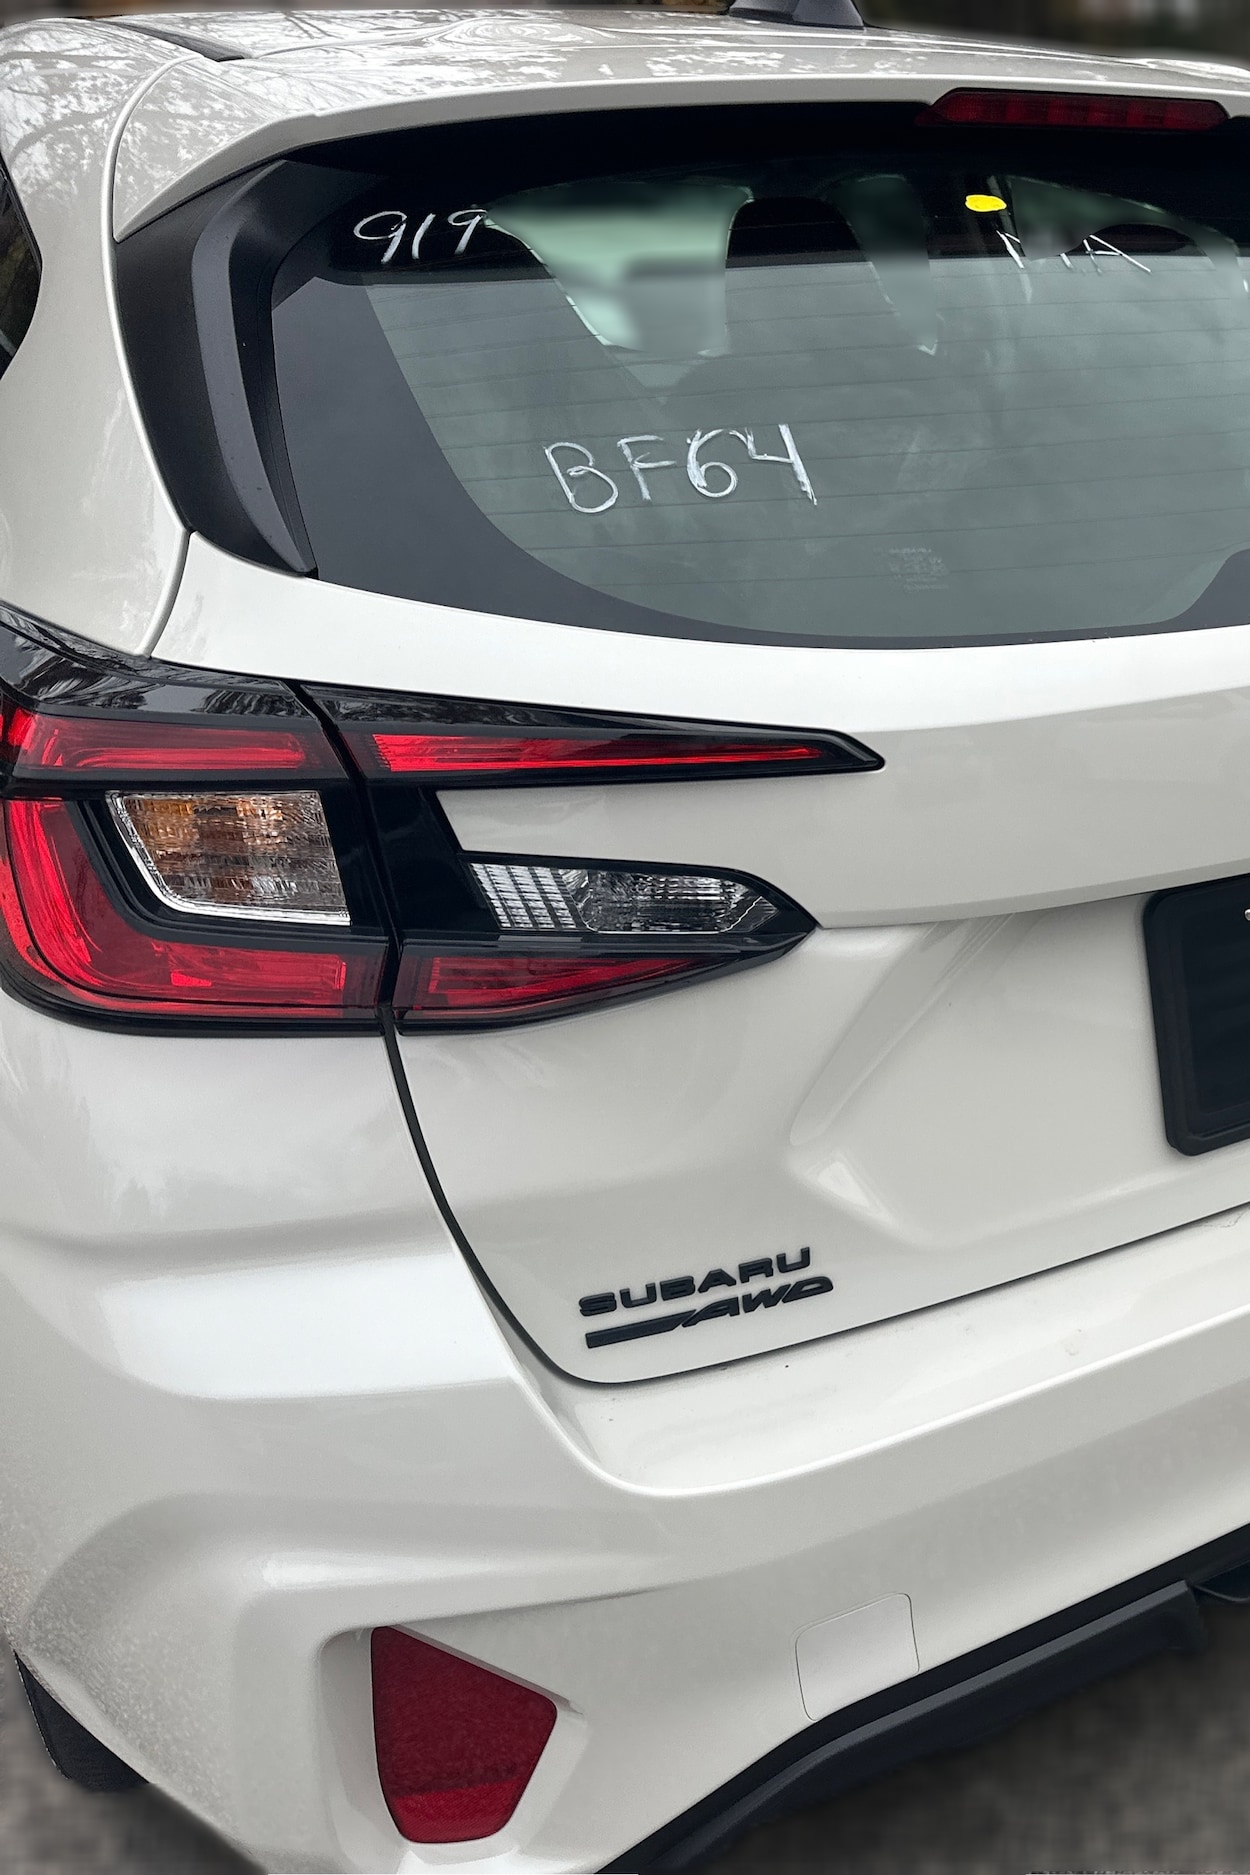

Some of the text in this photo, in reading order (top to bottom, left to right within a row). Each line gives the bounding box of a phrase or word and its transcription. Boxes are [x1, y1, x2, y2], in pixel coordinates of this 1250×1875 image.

[353, 209, 487, 264] 919
[543, 423, 818, 514] BF64
[578, 1246, 811, 1317] SUBARU
[681, 1275, 835, 1328] AWD
